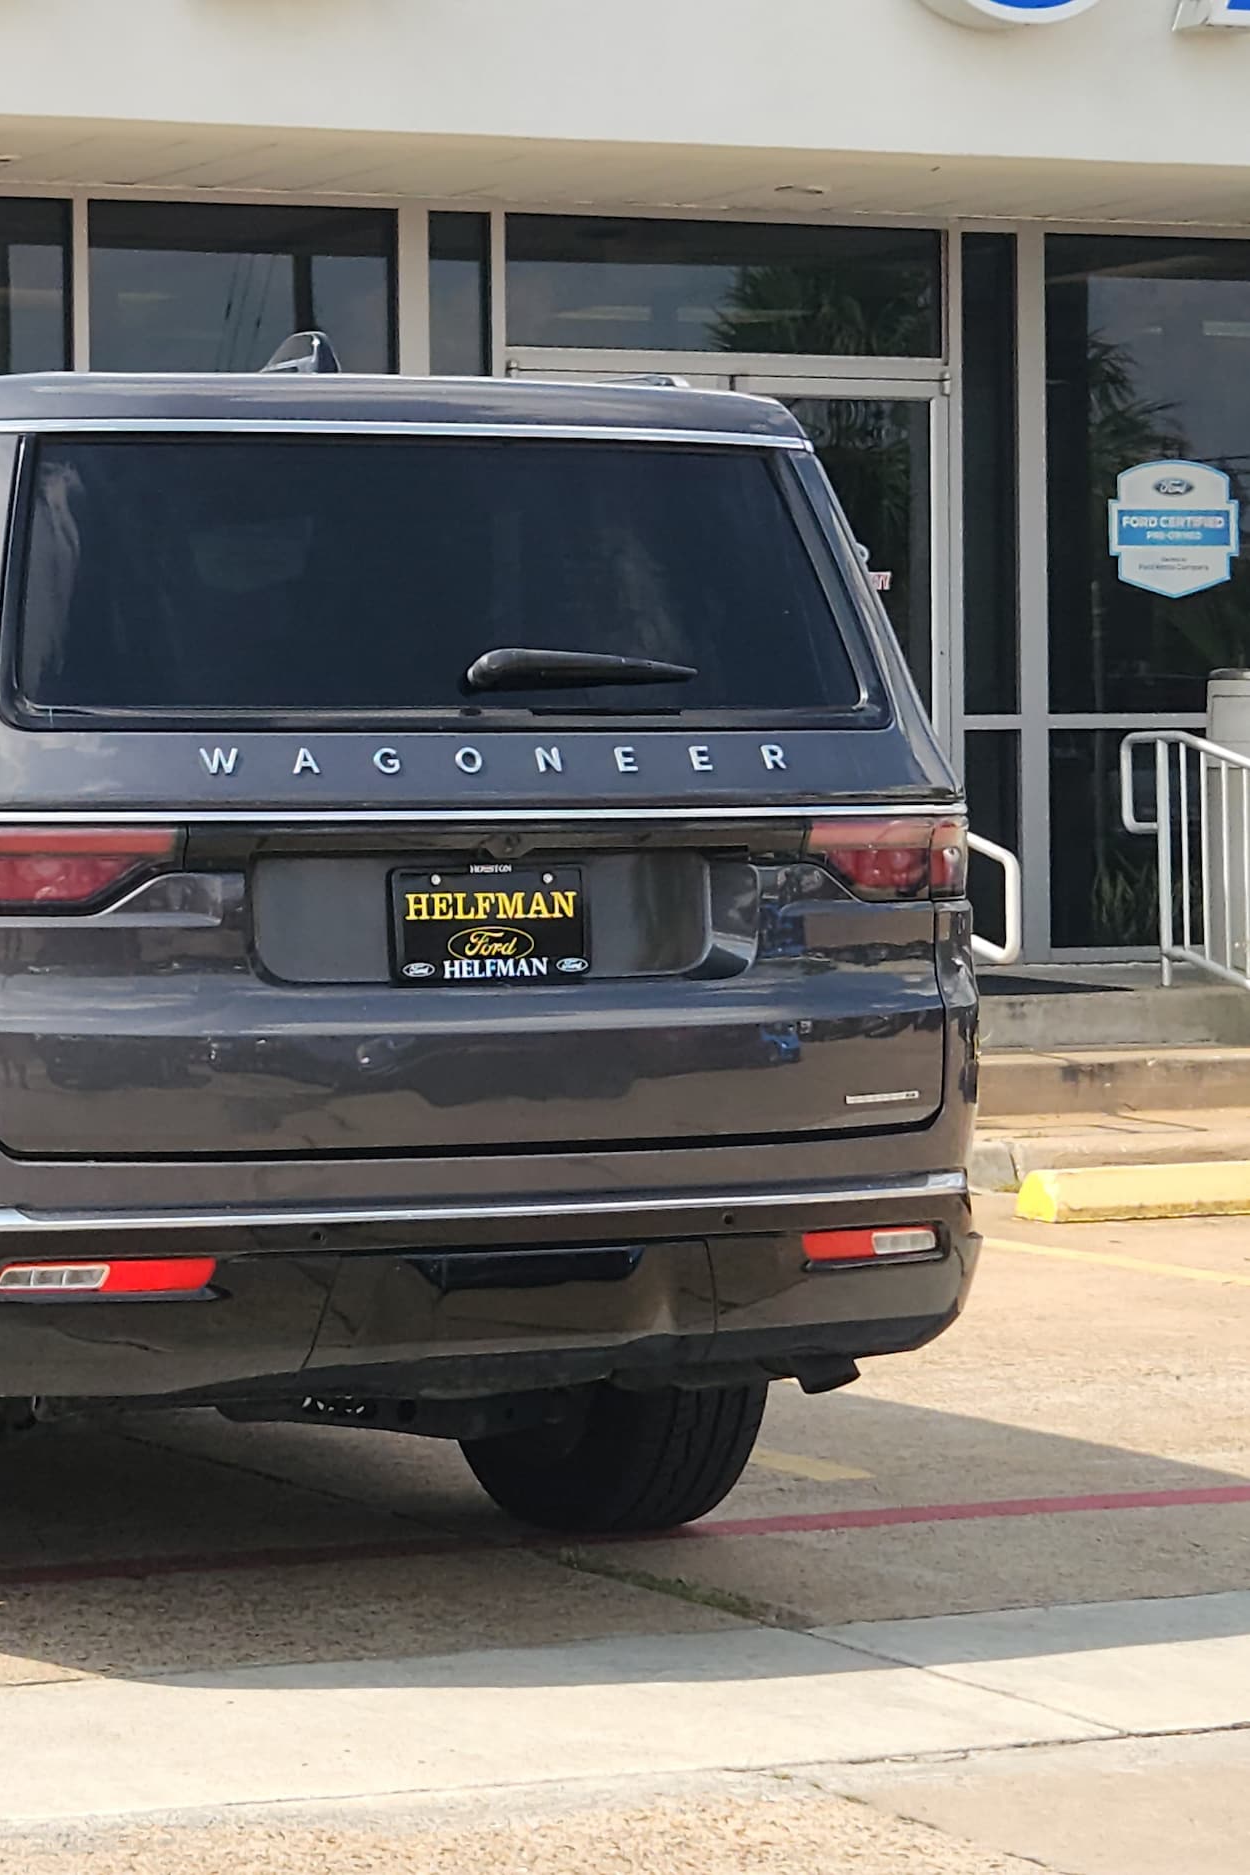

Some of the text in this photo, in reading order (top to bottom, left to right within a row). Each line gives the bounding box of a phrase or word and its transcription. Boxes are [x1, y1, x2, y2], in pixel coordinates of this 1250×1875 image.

[1122, 515, 1225, 529] FORD CERTIFIED
[200, 743, 787, 775] WAGONEER
[404, 890, 578, 921] HELFMAN
[464, 930, 518, 957] Ford
[442, 957, 549, 980] HELFMAN
